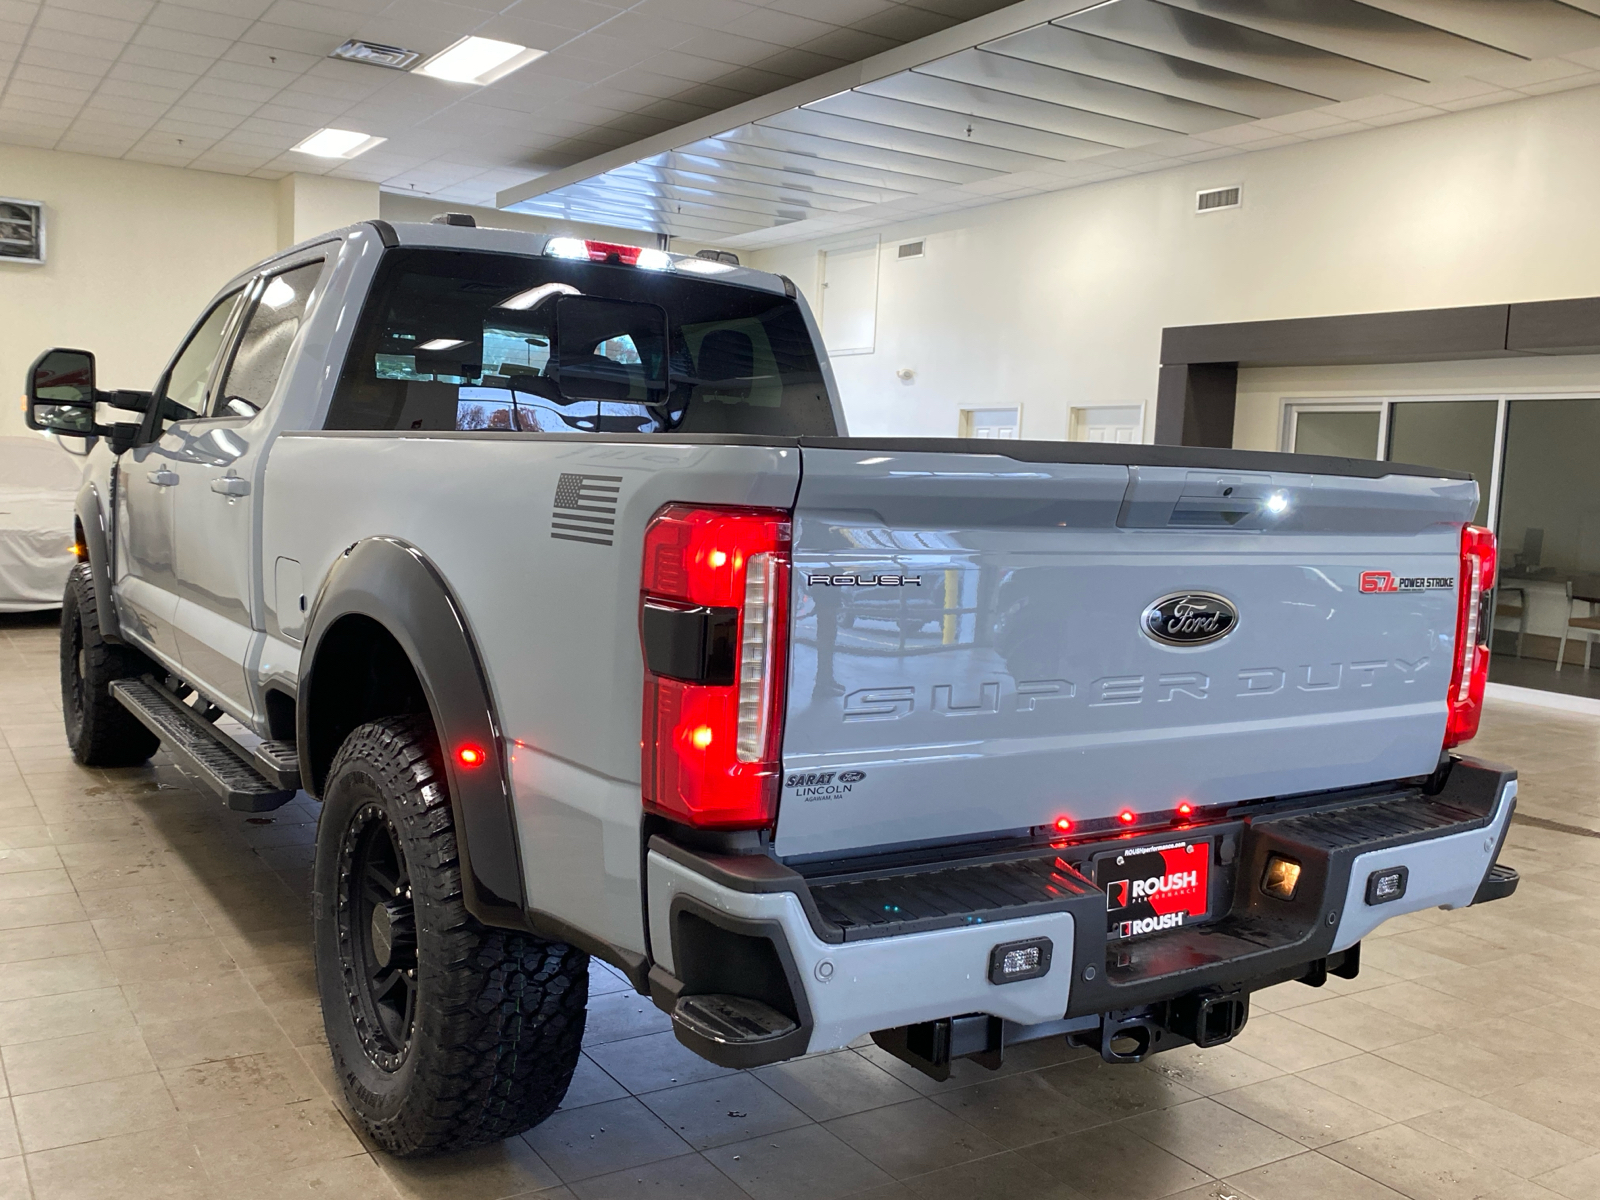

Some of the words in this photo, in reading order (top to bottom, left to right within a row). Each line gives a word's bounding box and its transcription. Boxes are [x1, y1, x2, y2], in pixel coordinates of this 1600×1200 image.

[807, 574, 922, 587] ROUSH
[1398, 577, 1425, 588] POWER
[1426, 577, 1454, 588] STROKE
[1167, 595, 1221, 635] Ford
[842, 671, 1210, 723] SUPER
[1237, 656, 1430, 697] DUTY
[785, 772, 836, 788] SARAT
[796, 785, 852, 796] LINCOLN
[1132, 870, 1197, 898] ROUSH
[1132, 887, 1197, 904] PERFORMANCE
[1132, 912, 1184, 935] ROUSH
